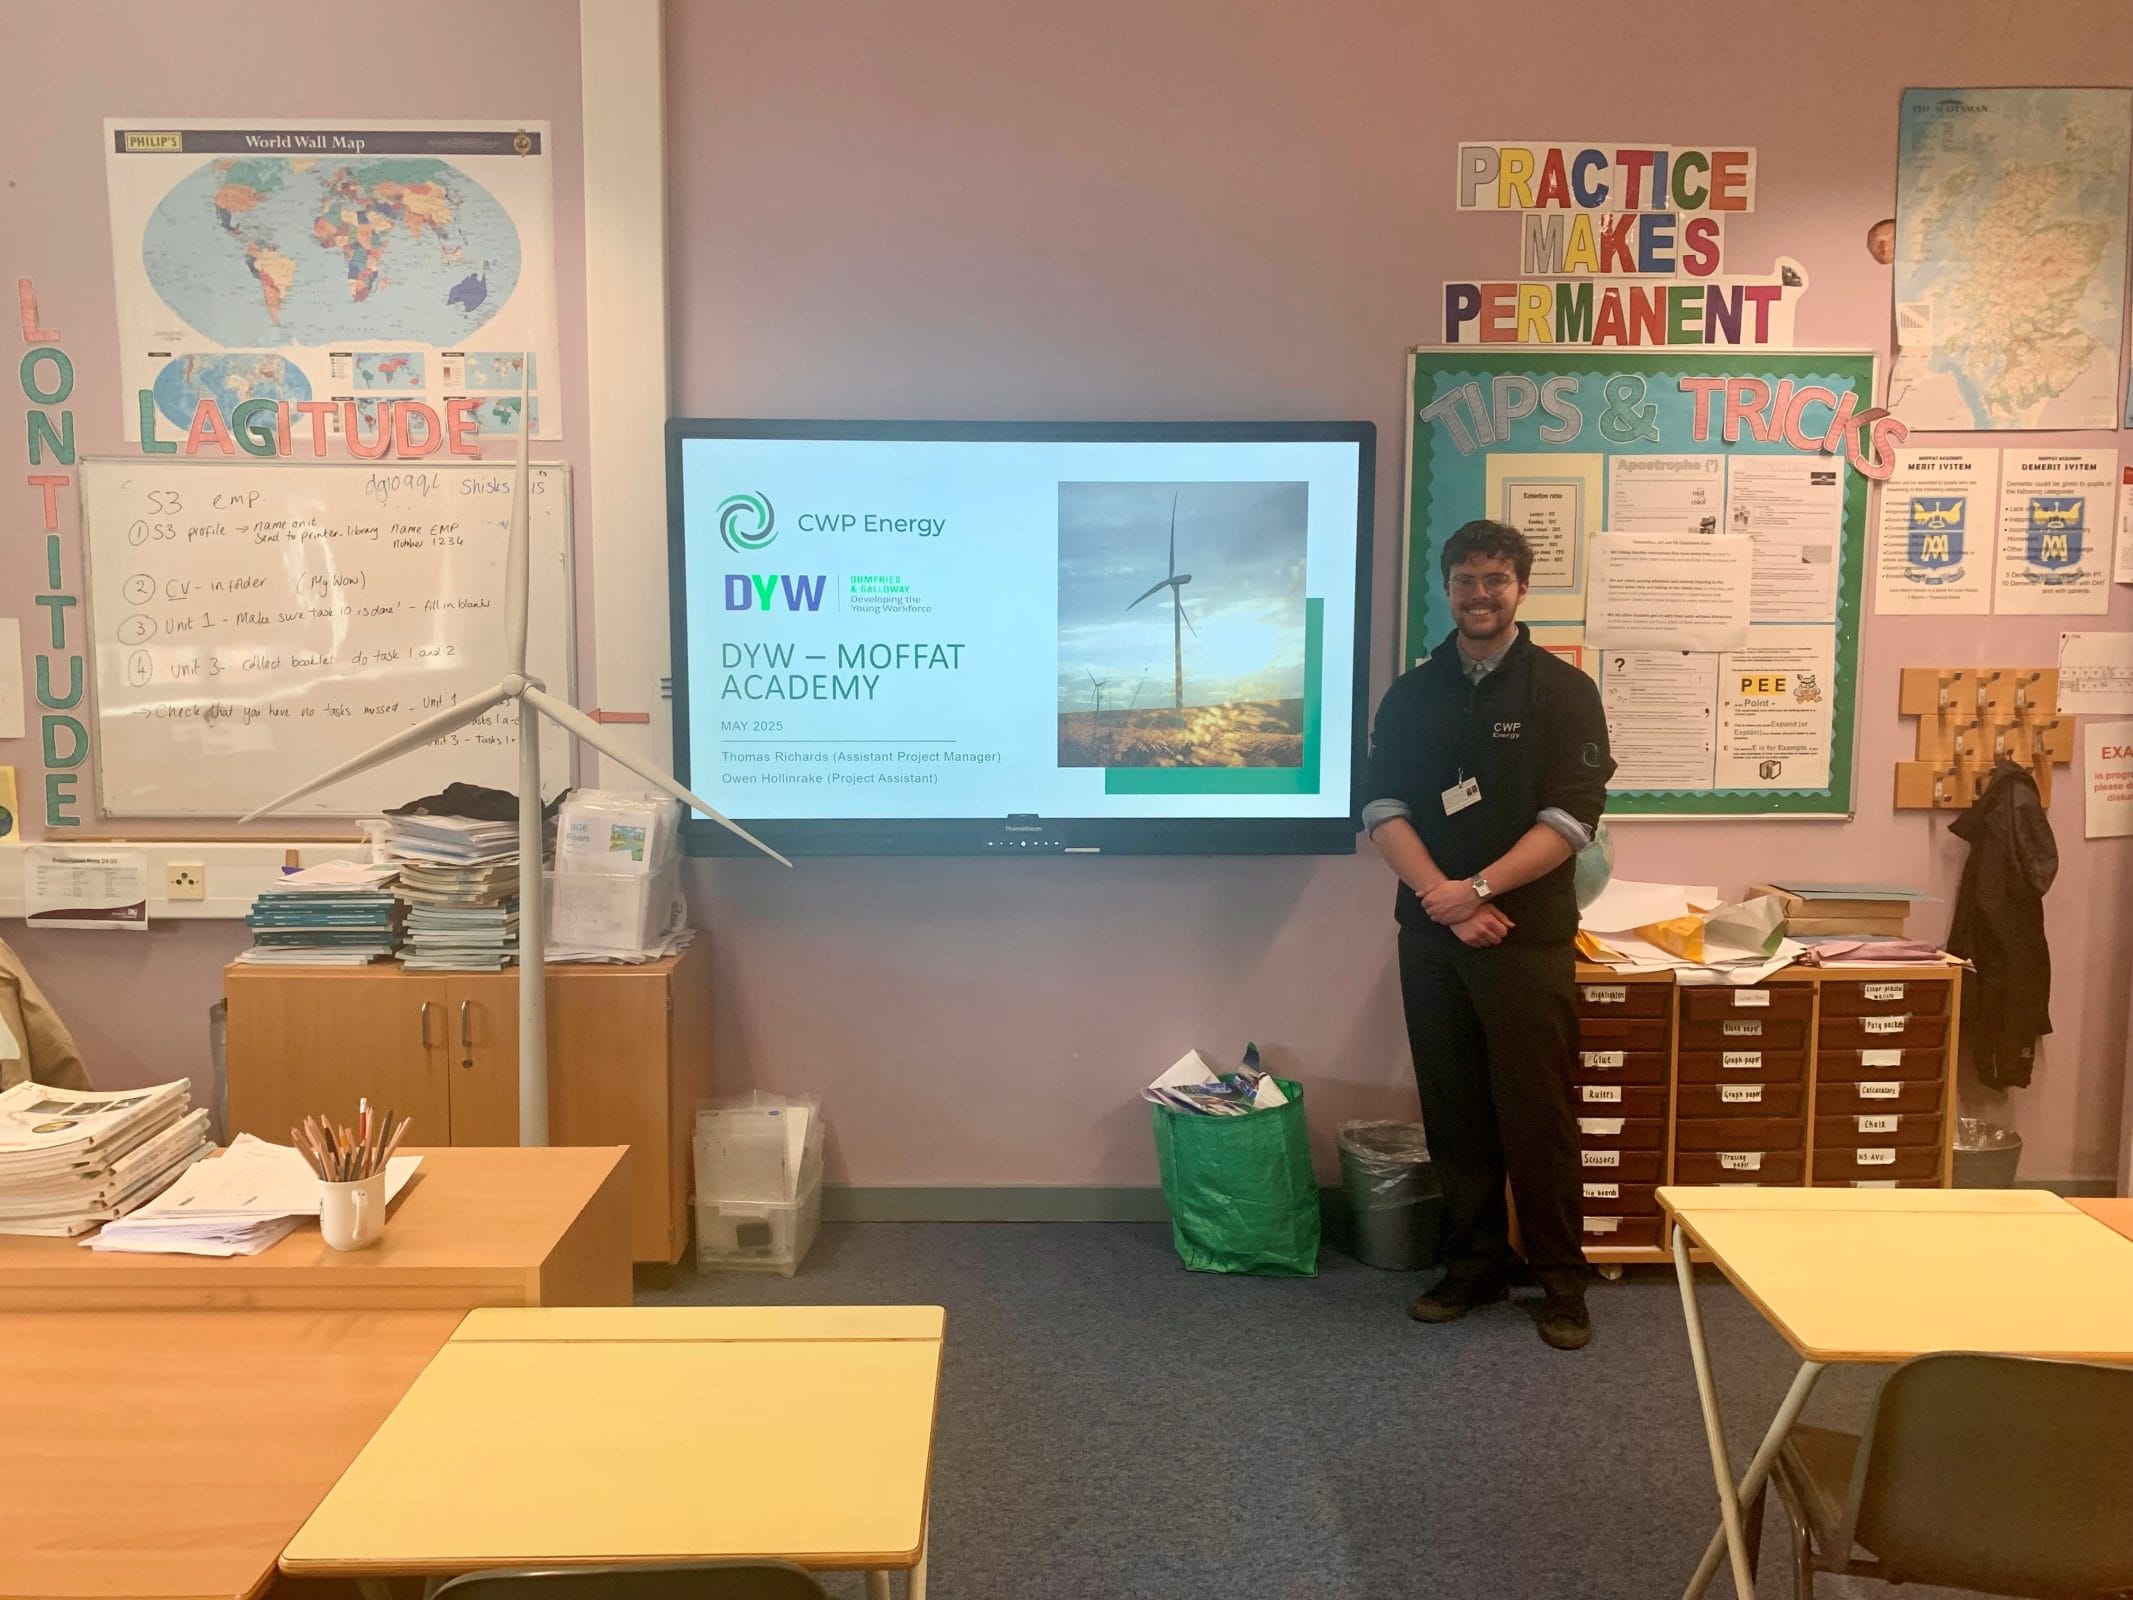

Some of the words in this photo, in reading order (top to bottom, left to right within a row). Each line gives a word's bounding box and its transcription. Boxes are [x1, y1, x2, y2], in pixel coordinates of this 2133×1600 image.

[130, 136, 177, 148] PHILIP'S
[245, 135, 292, 148] World
[294, 136, 326, 149] Wall
[332, 136, 366, 154] Map
[1460, 146, 1749, 210] PRACTICE
[1524, 212, 1720, 278] MAKES
[1446, 282, 1782, 346] PERMANENT
[1420, 376, 1582, 456] TIPS
[1598, 374, 1660, 444] &
[1679, 376, 1908, 480] TRICKS
[1617, 460, 1700, 472] Apostrophe
[148, 490, 182, 514] S3
[152, 524, 176, 540] S3
[188, 522, 226, 542] profile
[430, 524, 460, 536] EMP
[798, 514, 856, 532] CWP
[864, 514, 946, 538] Energy
[286, 530, 296, 540] to
[347, 524, 379, 541] library
[432, 536, 464, 546] 1234
[850, 575, 902, 584] DUMFRIES
[166, 578, 192, 600] CV
[228, 576, 268, 592] folder
[724, 574, 828, 612] DYW
[850, 585, 857, 593] &
[860, 585, 910, 594] GALLOWAY
[850, 595, 903, 606] Developing
[906, 595, 922, 604] the
[850, 604, 881, 614] Young
[882, 604, 932, 614] Workforce
[166, 619, 194, 634] Unit
[202, 612, 215, 628] 1
[278, 611, 304, 623] sure
[308, 608, 334, 618] task
[340, 606, 352, 616] 10
[424, 600, 441, 612] fill
[292, 655, 336, 668] booklet
[352, 650, 368, 666] do
[374, 649, 400, 664] task
[418, 648, 440, 658] and
[446, 645, 456, 656] 2
[721, 642, 796, 669] DYW
[838, 643, 966, 670] MOFFAT
[720, 674, 880, 700] ACADEMY
[1744, 699, 1769, 708] Point
[155, 704, 200, 719] Check
[208, 702, 234, 719] that
[243, 706, 260, 726] you
[268, 704, 290, 718] have
[300, 706, 314, 718] no
[323, 702, 352, 718] tasks
[422, 694, 442, 709] Unit
[721, 720, 748, 732] MAY
[753, 720, 784, 732] 2025
[1494, 722, 1522, 732] CWP
[1772, 720, 1797, 728] Expand
[452, 735, 459, 746] 3
[476, 735, 502, 745] Tasks
[1492, 732, 1520, 740] Energy
[1778, 744, 1808, 752] Example
[721, 752, 770, 762] Thomas
[774, 751, 829, 762] Richards
[832, 751, 894, 764] (Assistant
[897, 752, 940, 764] Project
[944, 752, 1002, 764] Manager)
[722, 774, 757, 784] Owen
[762, 772, 823, 784] Hollinrake
[826, 772, 875, 786] (Project
[878, 772, 938, 785] Assistant)
[2094, 771, 2104, 780] in
[2094, 782, 2124, 794] please
[1744, 1024, 1760, 1033] paper
[1593, 1054, 1612, 1064] Glue
[1724, 1056, 1742, 1066] Graph
[1744, 1056, 1761, 1066] paper
[1589, 1090, 1614, 1099] Rulers
[1724, 1090, 1743, 1099] Graph
[1745, 1090, 1762, 1099] paper
[1864, 1120, 1886, 1128] Chalk
[1584, 1154, 1615, 1164] Scissors
[1724, 1154, 1746, 1162] Tracing
